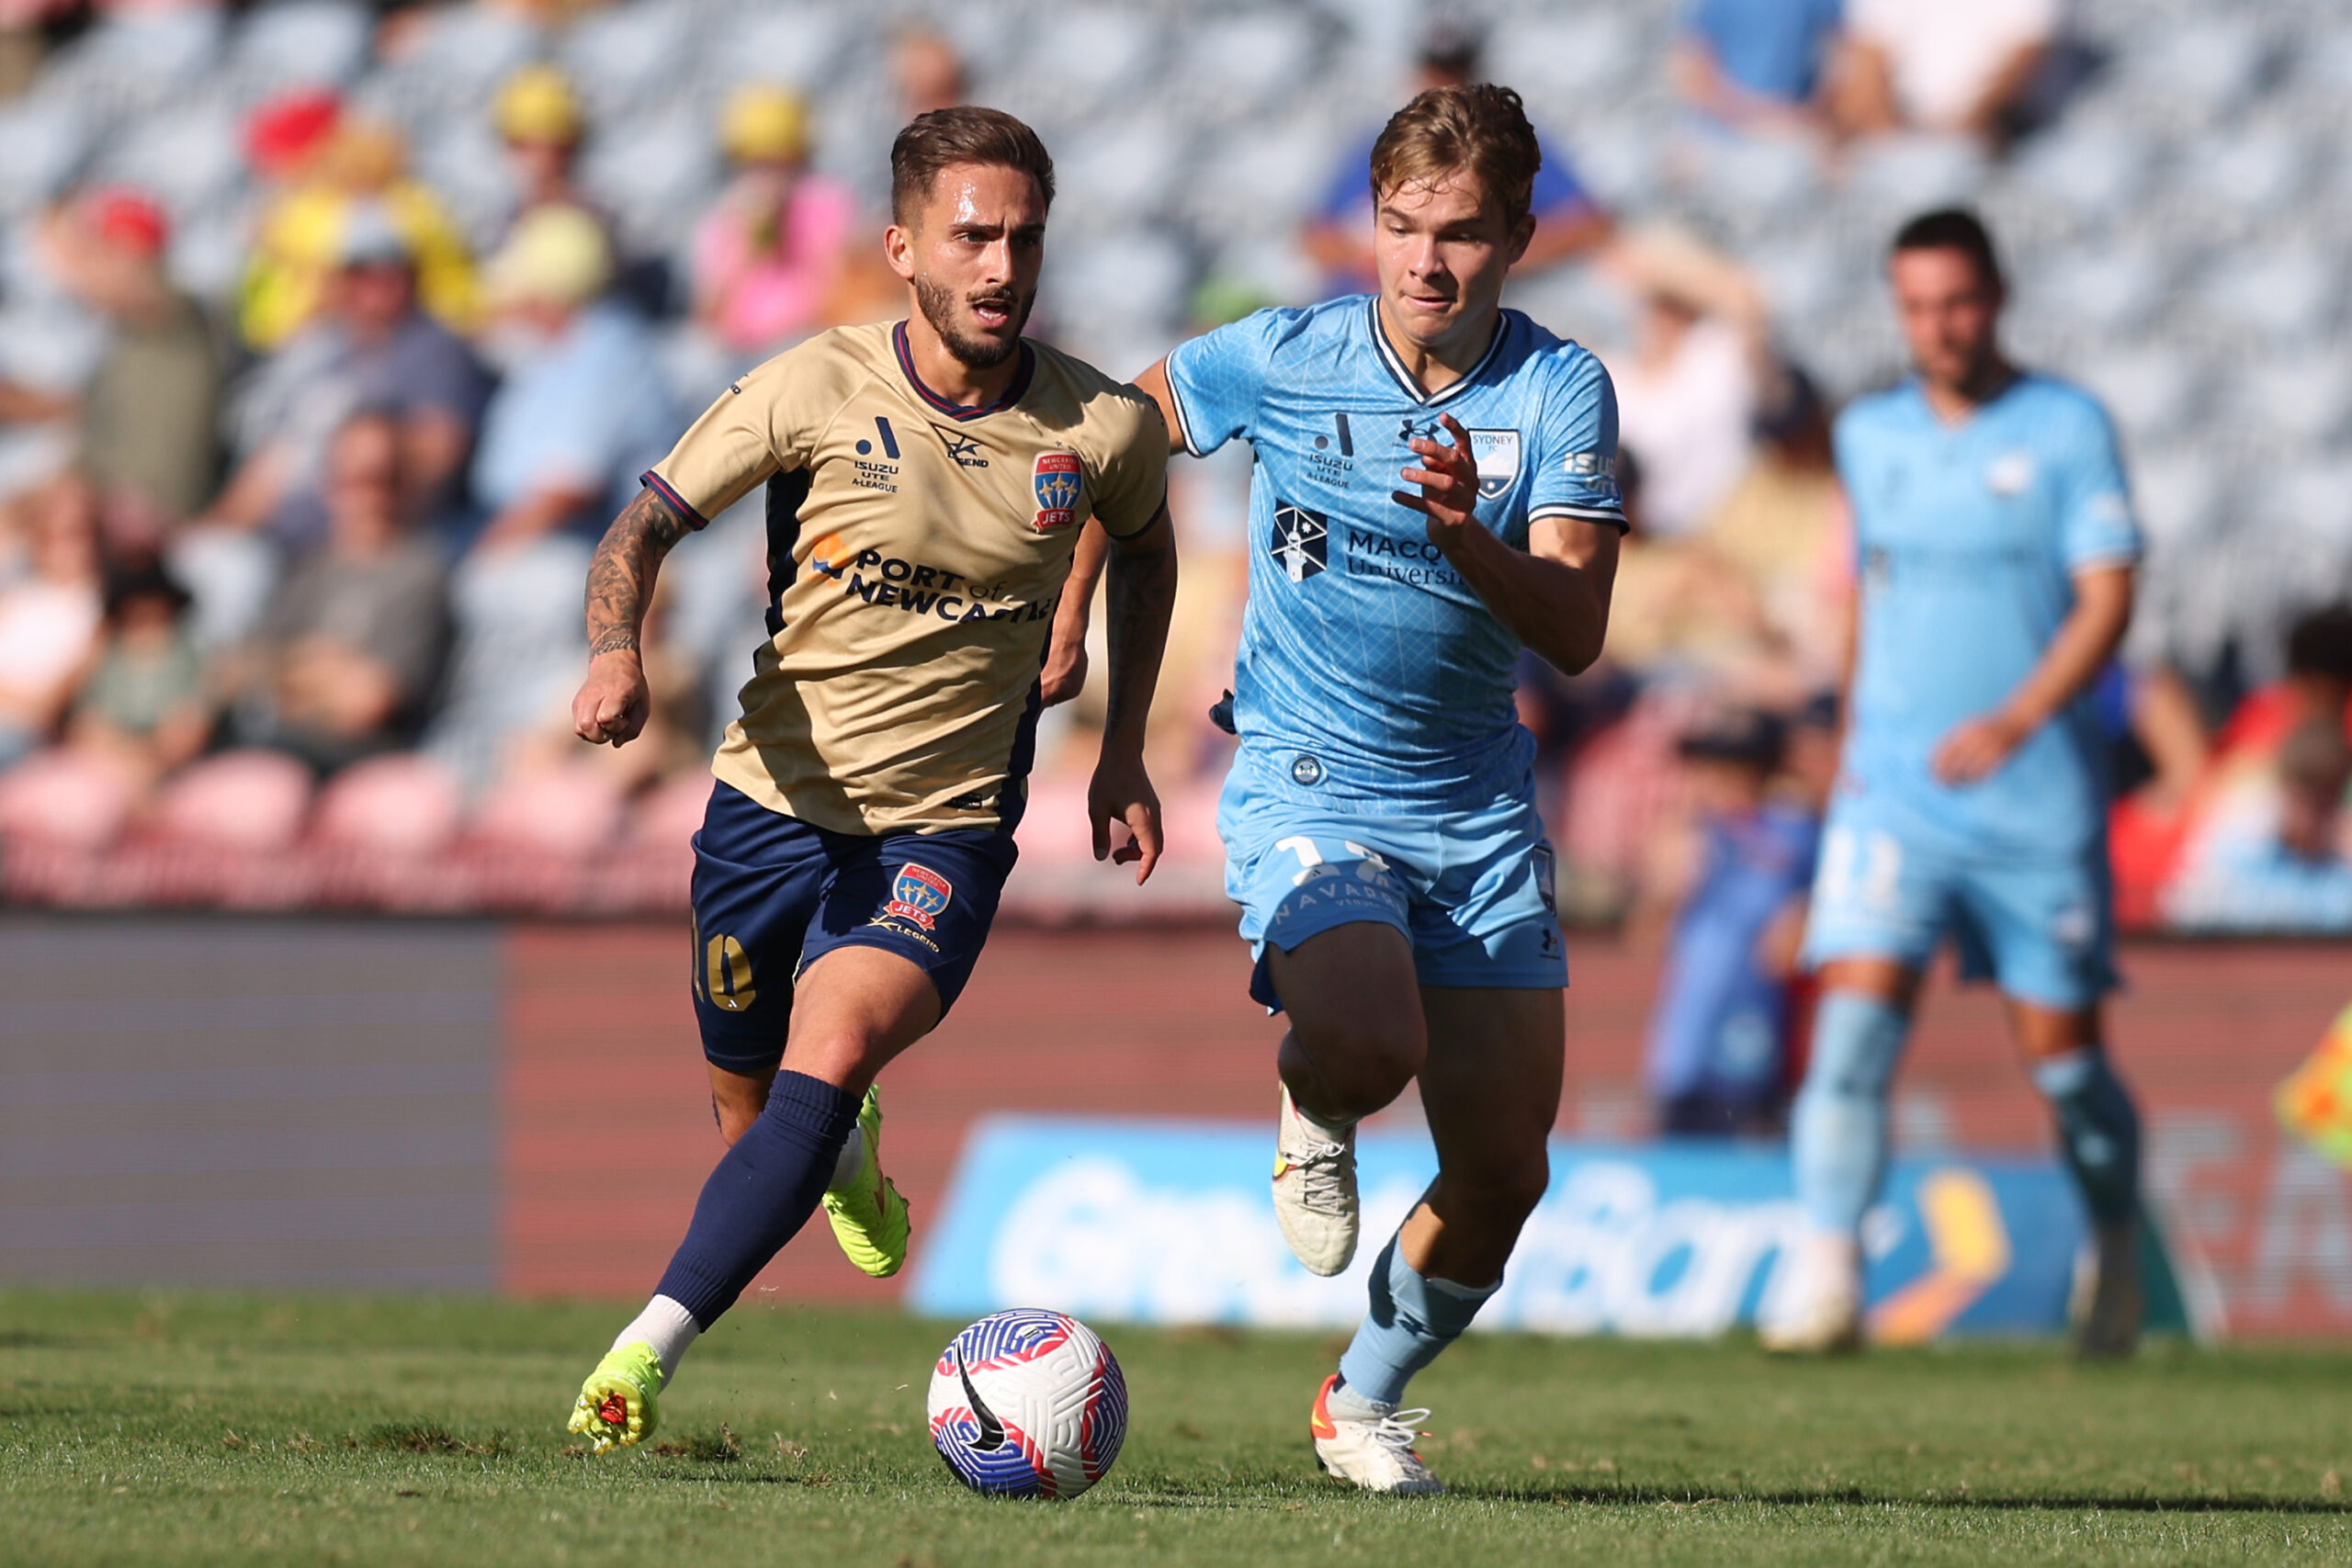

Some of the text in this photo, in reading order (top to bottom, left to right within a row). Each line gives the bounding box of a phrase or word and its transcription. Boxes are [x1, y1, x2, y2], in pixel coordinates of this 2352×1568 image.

[1472, 434, 1513, 446] SYDNEY
[854, 460, 899, 475] ISUZU
[947, 450, 989, 468] LEND
[1309, 454, 1353, 471] ISUZU
[1564, 453, 1616, 476] ISU
[861, 470, 889, 482] UTE
[1317, 465, 1342, 477] UTE
[852, 478, 898, 493] A-LEAGUE
[1306, 471, 1350, 490] A-LEAGUE
[1043, 511, 1070, 525] JETS
[856, 549, 1008, 602] PORT of
[1347, 558, 1468, 586] Universi
[895, 904, 928, 922] JETS
[897, 925, 940, 953] LEGEND
